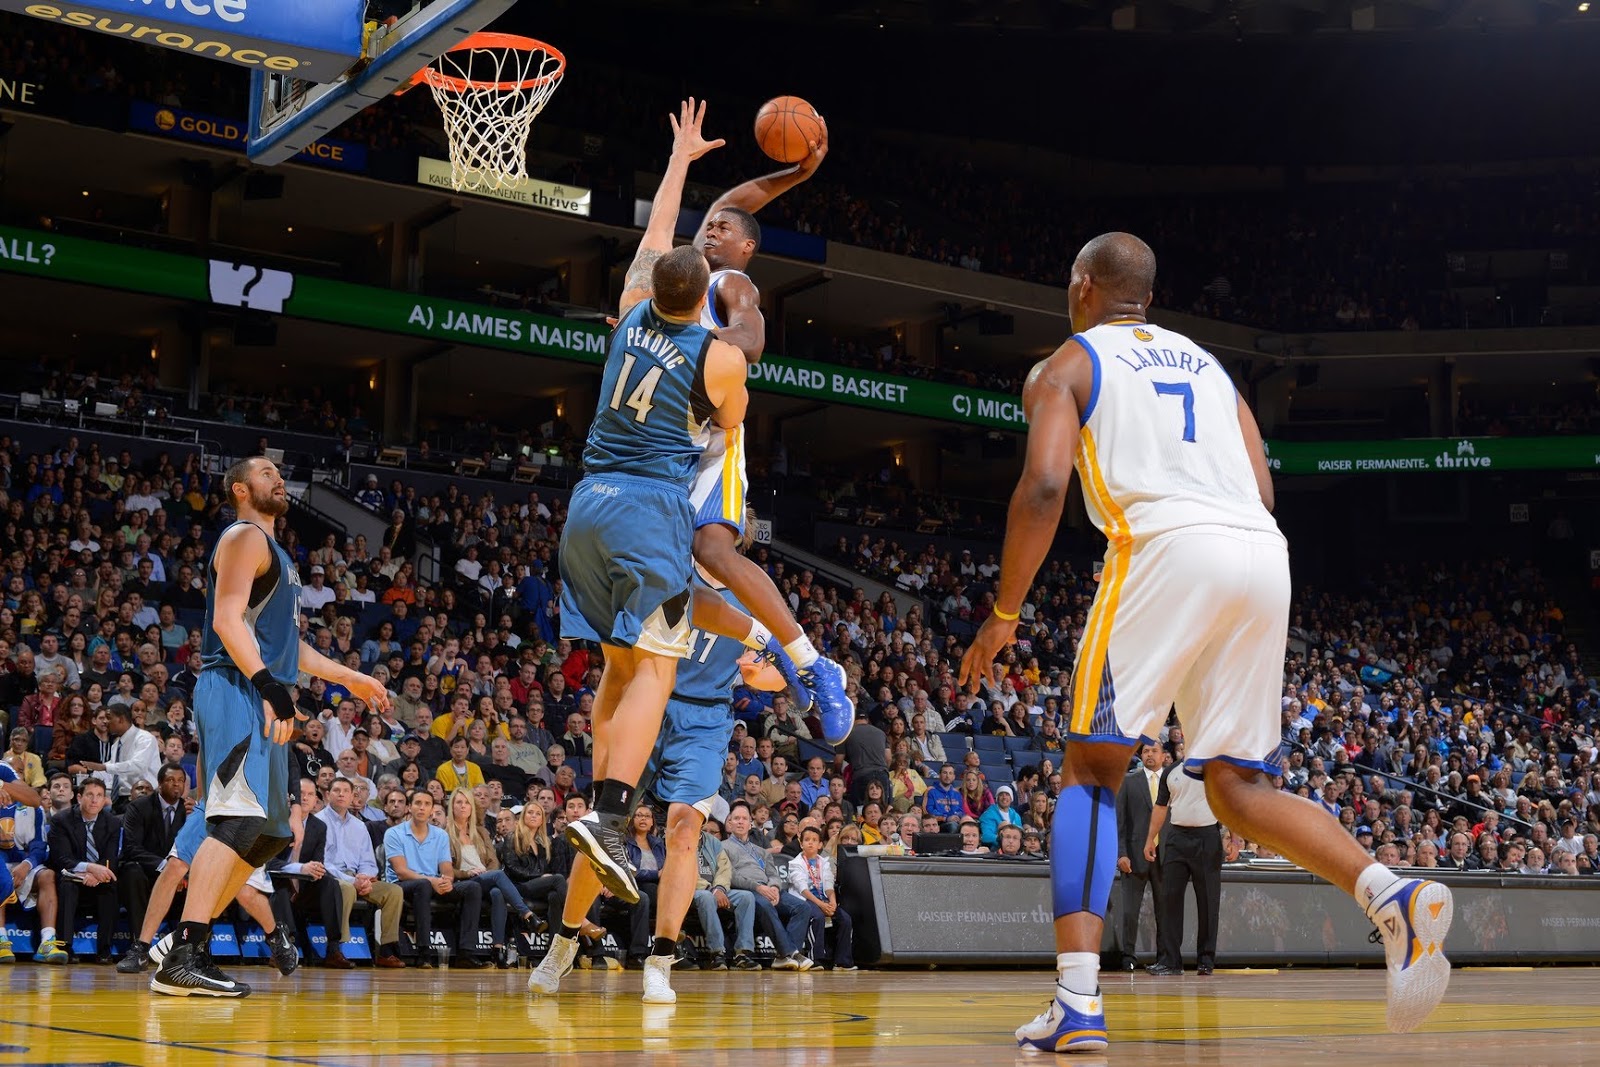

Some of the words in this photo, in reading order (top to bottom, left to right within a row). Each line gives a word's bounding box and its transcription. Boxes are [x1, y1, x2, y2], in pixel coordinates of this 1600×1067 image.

[180, 116, 239, 141] GOLD
[429, 173, 460, 188] KAIS
[531, 188, 579, 212] thrive
[408, 304, 434, 330] A)
[441, 310, 522, 342] JAMES
[832, 373, 909, 404] BASKET
[952, 393, 972, 416] C)
[626, 326, 686, 371] PEKOVIC
[1115, 347, 1210, 376] LANDRY
[609, 350, 666, 425] 14
[1150, 379, 1197, 443] 7
[1318, 460, 1353, 471] KAISER
[1435, 451, 1492, 469] thrive
[917, 911, 953, 922] KAISER
[957, 911, 1028, 923] PERMANENTE
